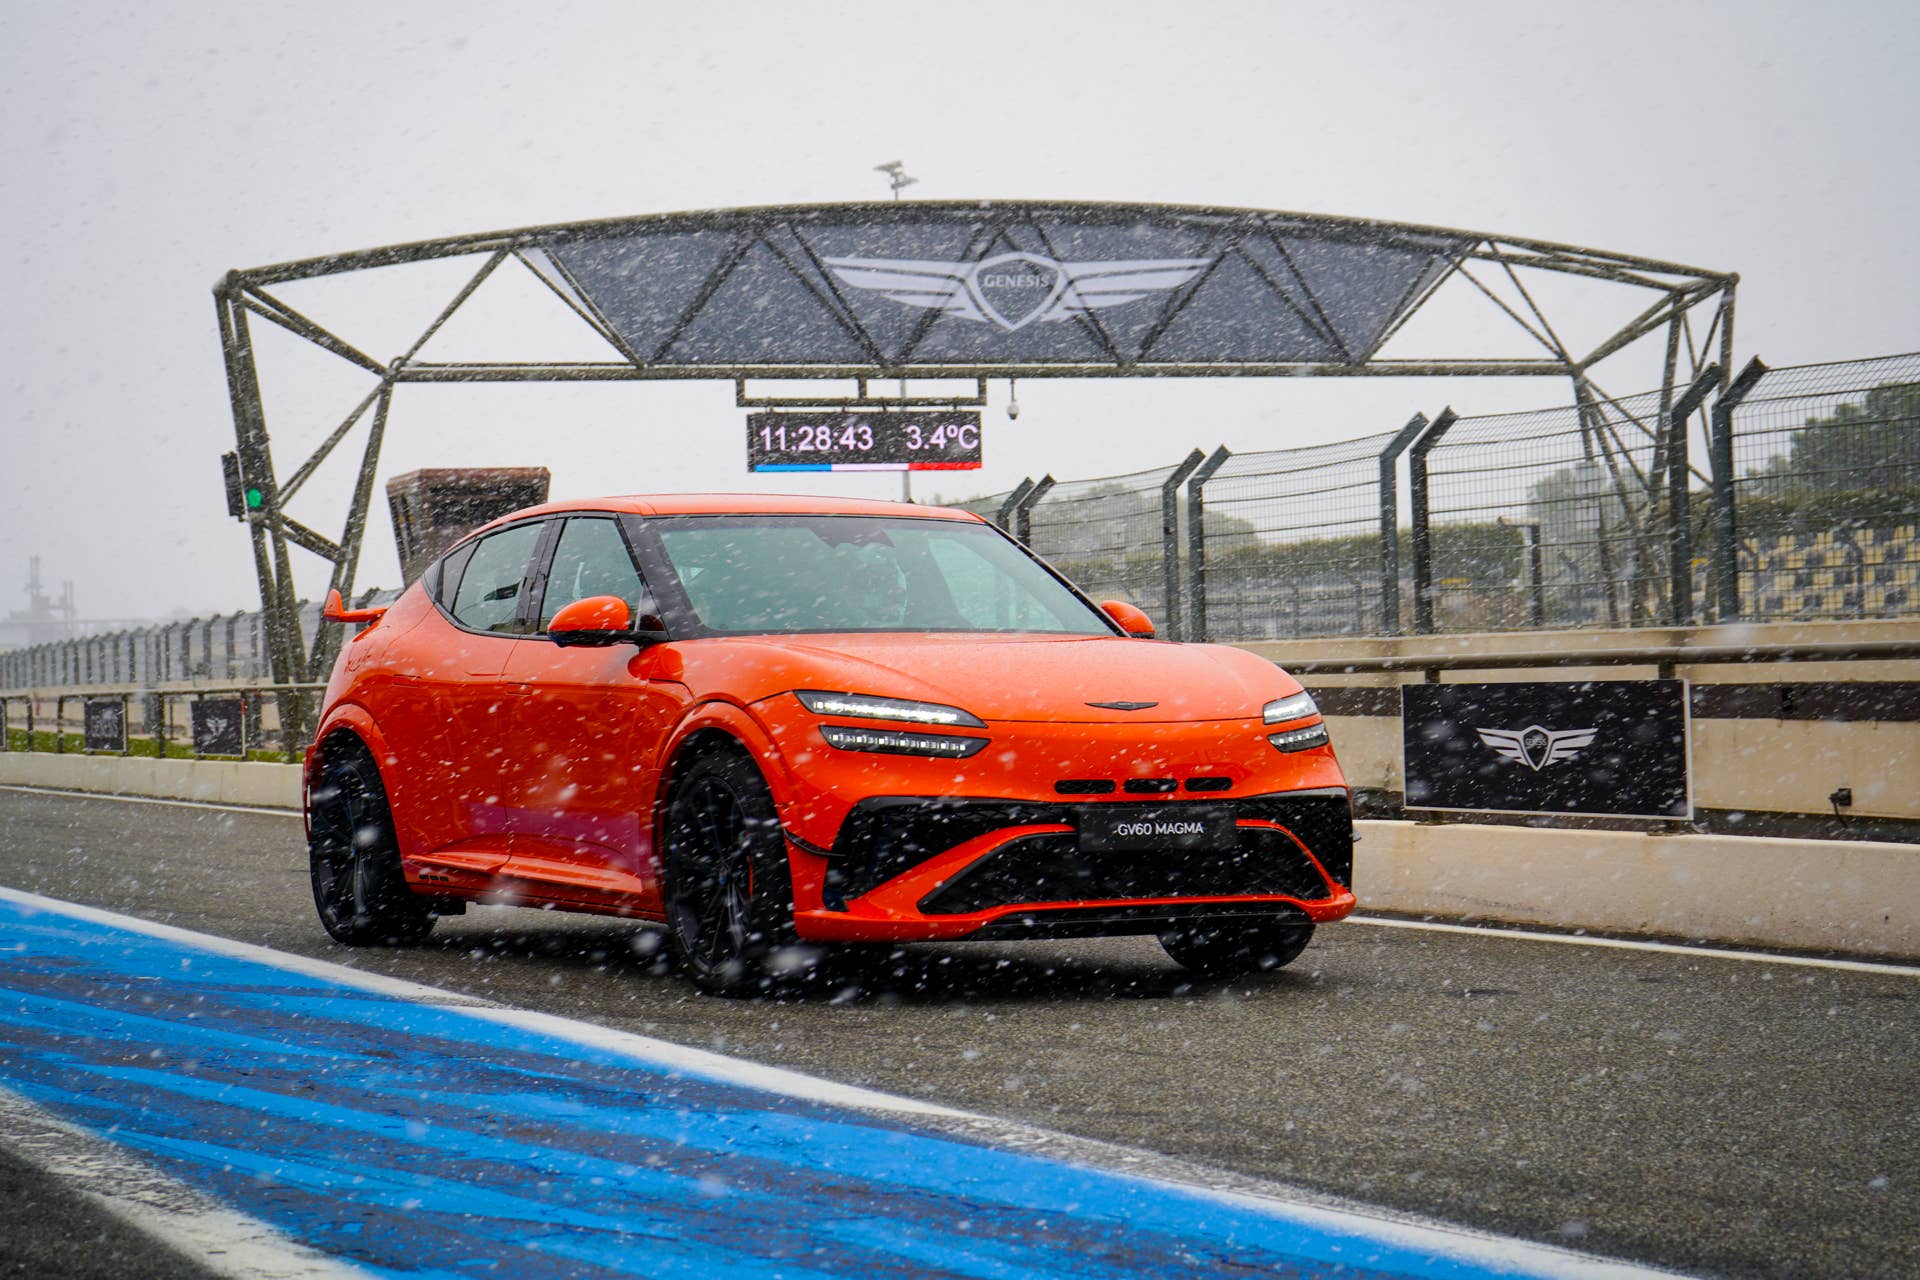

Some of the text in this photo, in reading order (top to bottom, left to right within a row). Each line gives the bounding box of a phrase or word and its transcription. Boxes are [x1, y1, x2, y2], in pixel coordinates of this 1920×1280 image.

[984, 274, 1050, 288] GENESIS
[760, 425, 874, 451] 11:28:43
[1117, 822, 1204, 836] GV60 MAGMA
